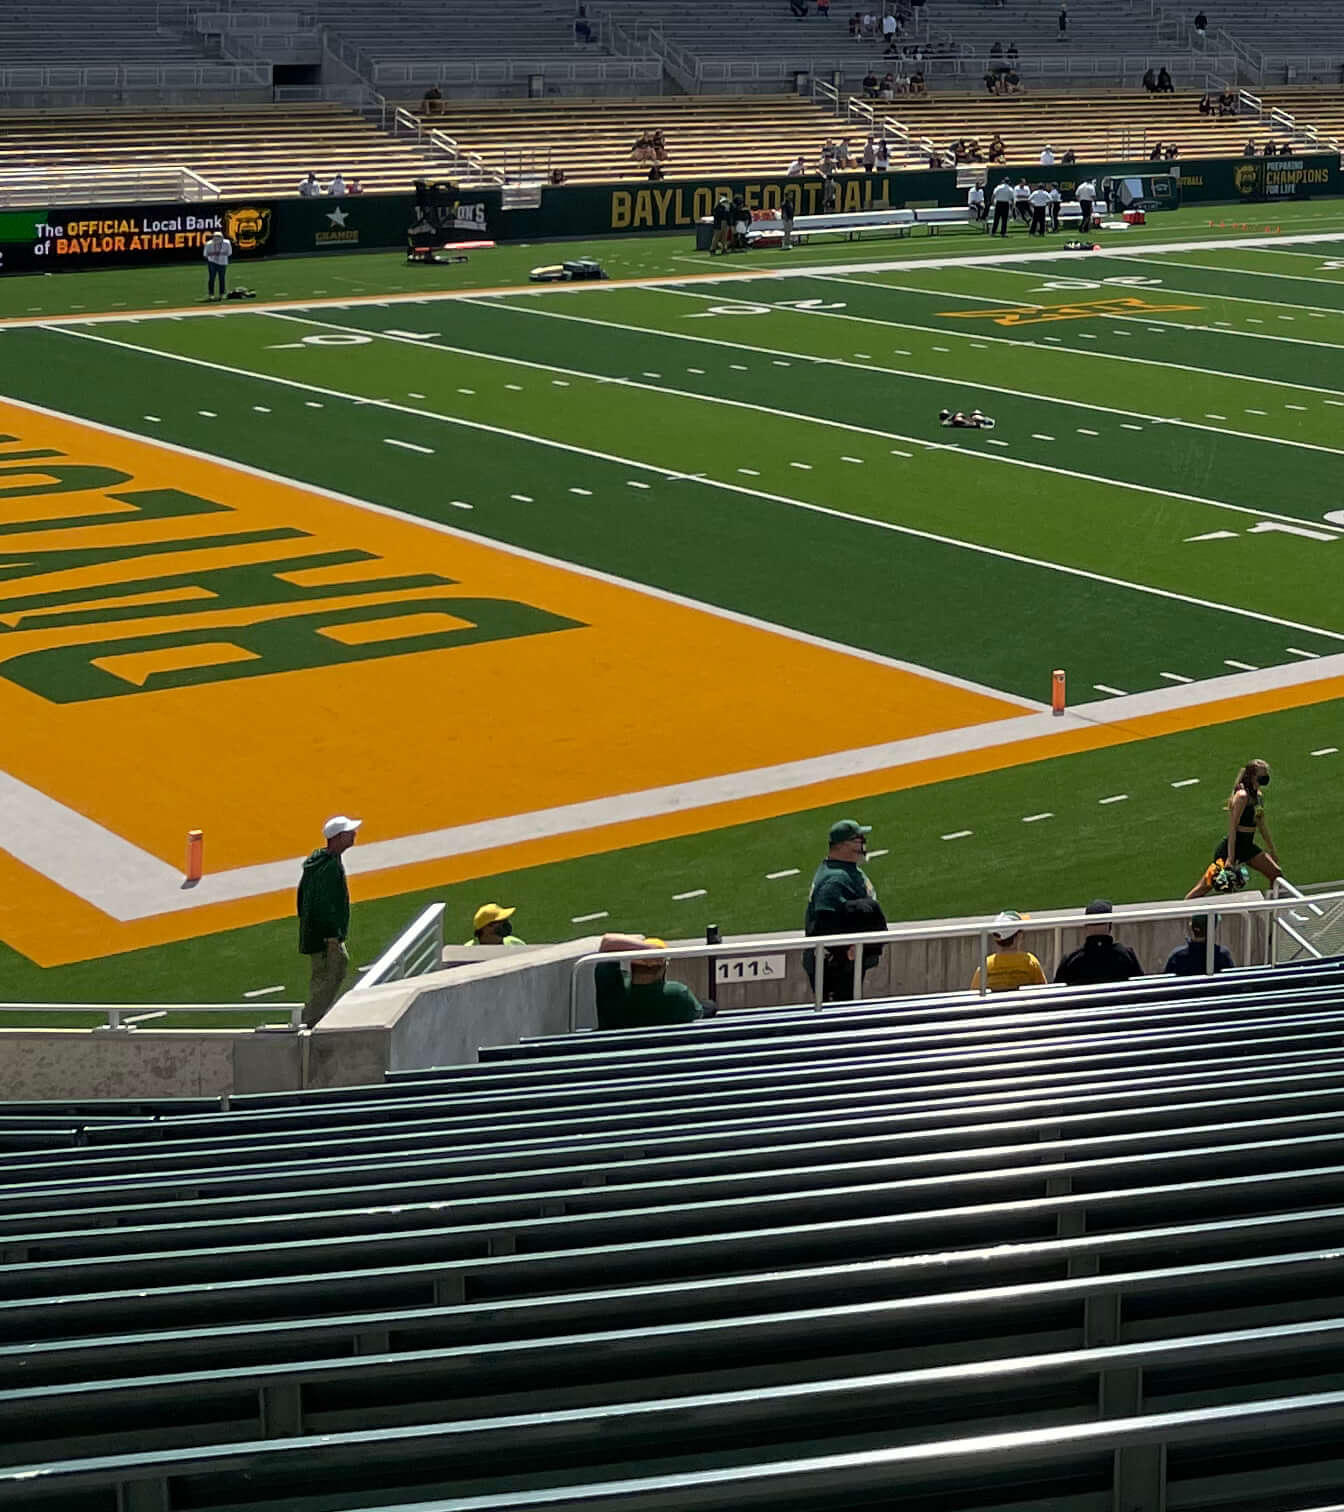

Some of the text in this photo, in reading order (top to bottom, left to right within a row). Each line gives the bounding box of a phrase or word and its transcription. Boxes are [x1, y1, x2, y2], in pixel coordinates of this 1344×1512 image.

[1266, 168, 1329, 185] CHAMPIONS
[34, 215, 222, 238] The OFFICIAL Local Bank
[34, 231, 211, 256] of BAYLOR ATHLETIC
[718, 960, 759, 980] 111
